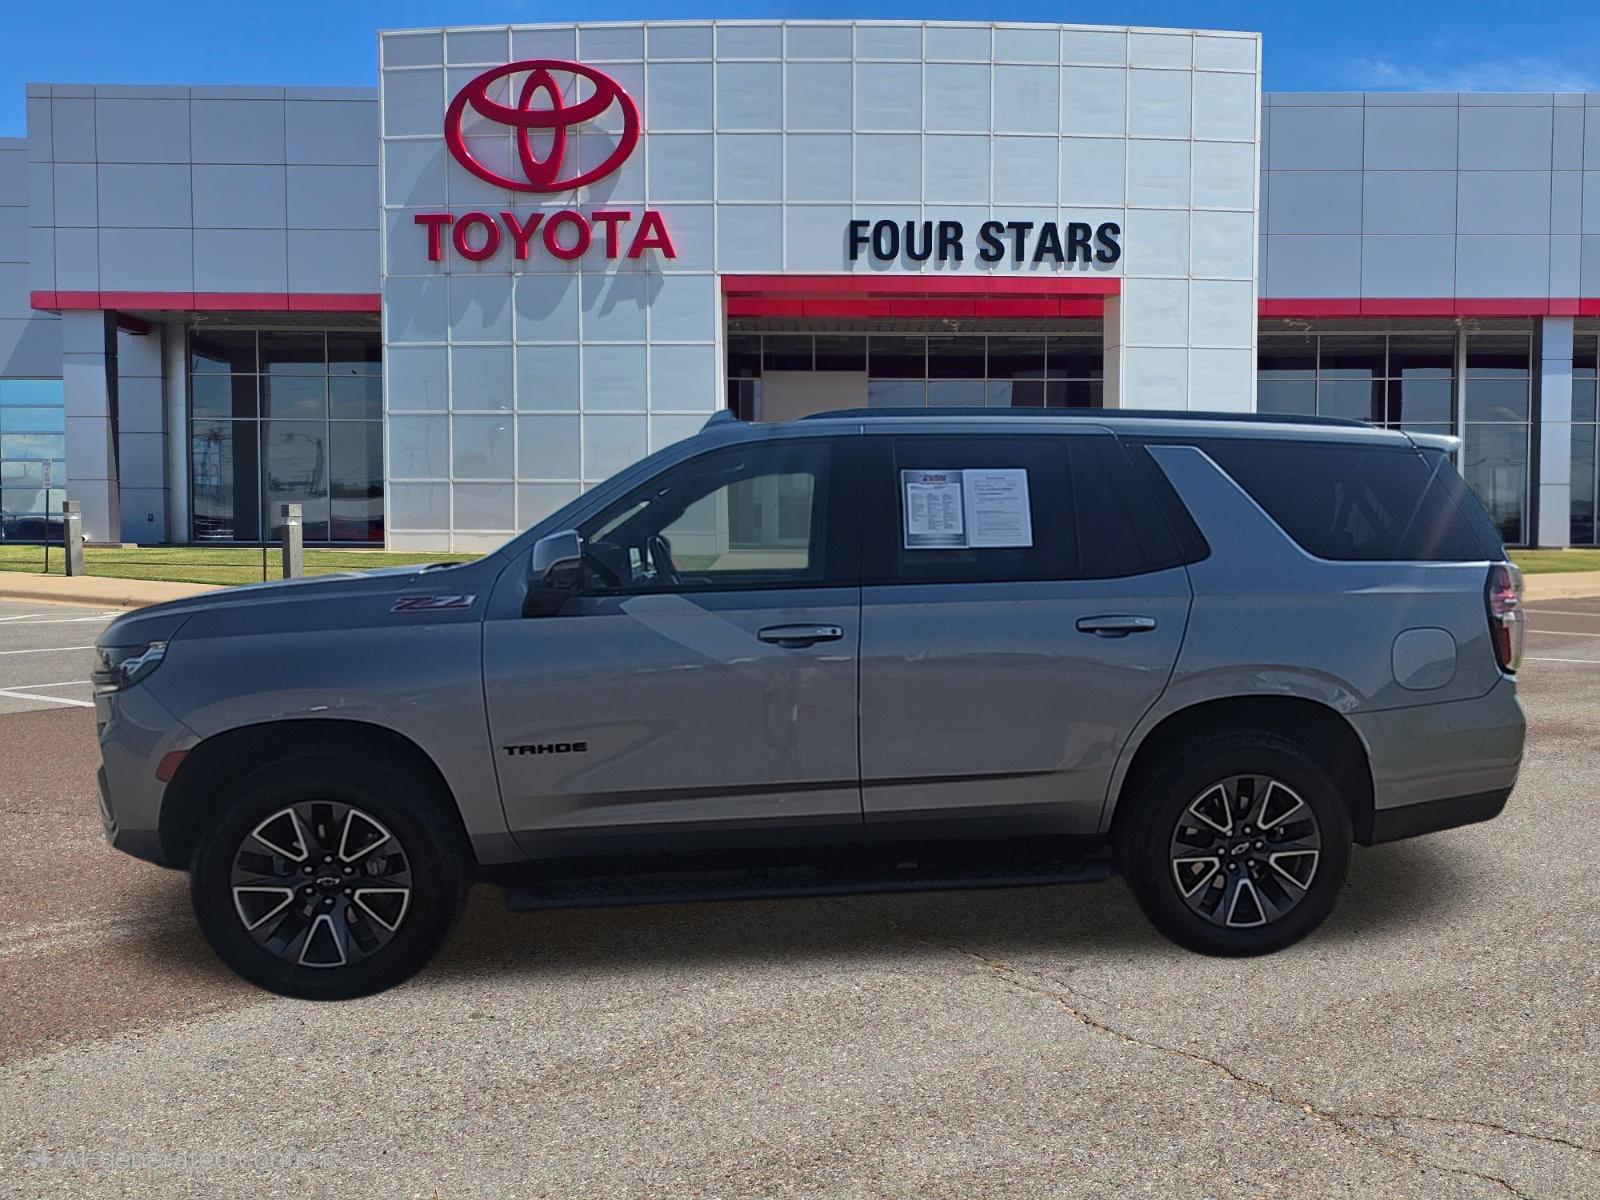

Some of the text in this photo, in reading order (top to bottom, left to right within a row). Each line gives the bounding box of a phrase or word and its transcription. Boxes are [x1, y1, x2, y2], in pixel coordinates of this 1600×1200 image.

[414, 210, 677, 261] TOYOTA
[850, 219, 1122, 263] FOUR STARS
[390, 594, 477, 613] Z71
[502, 742, 588, 756] TAHOE
